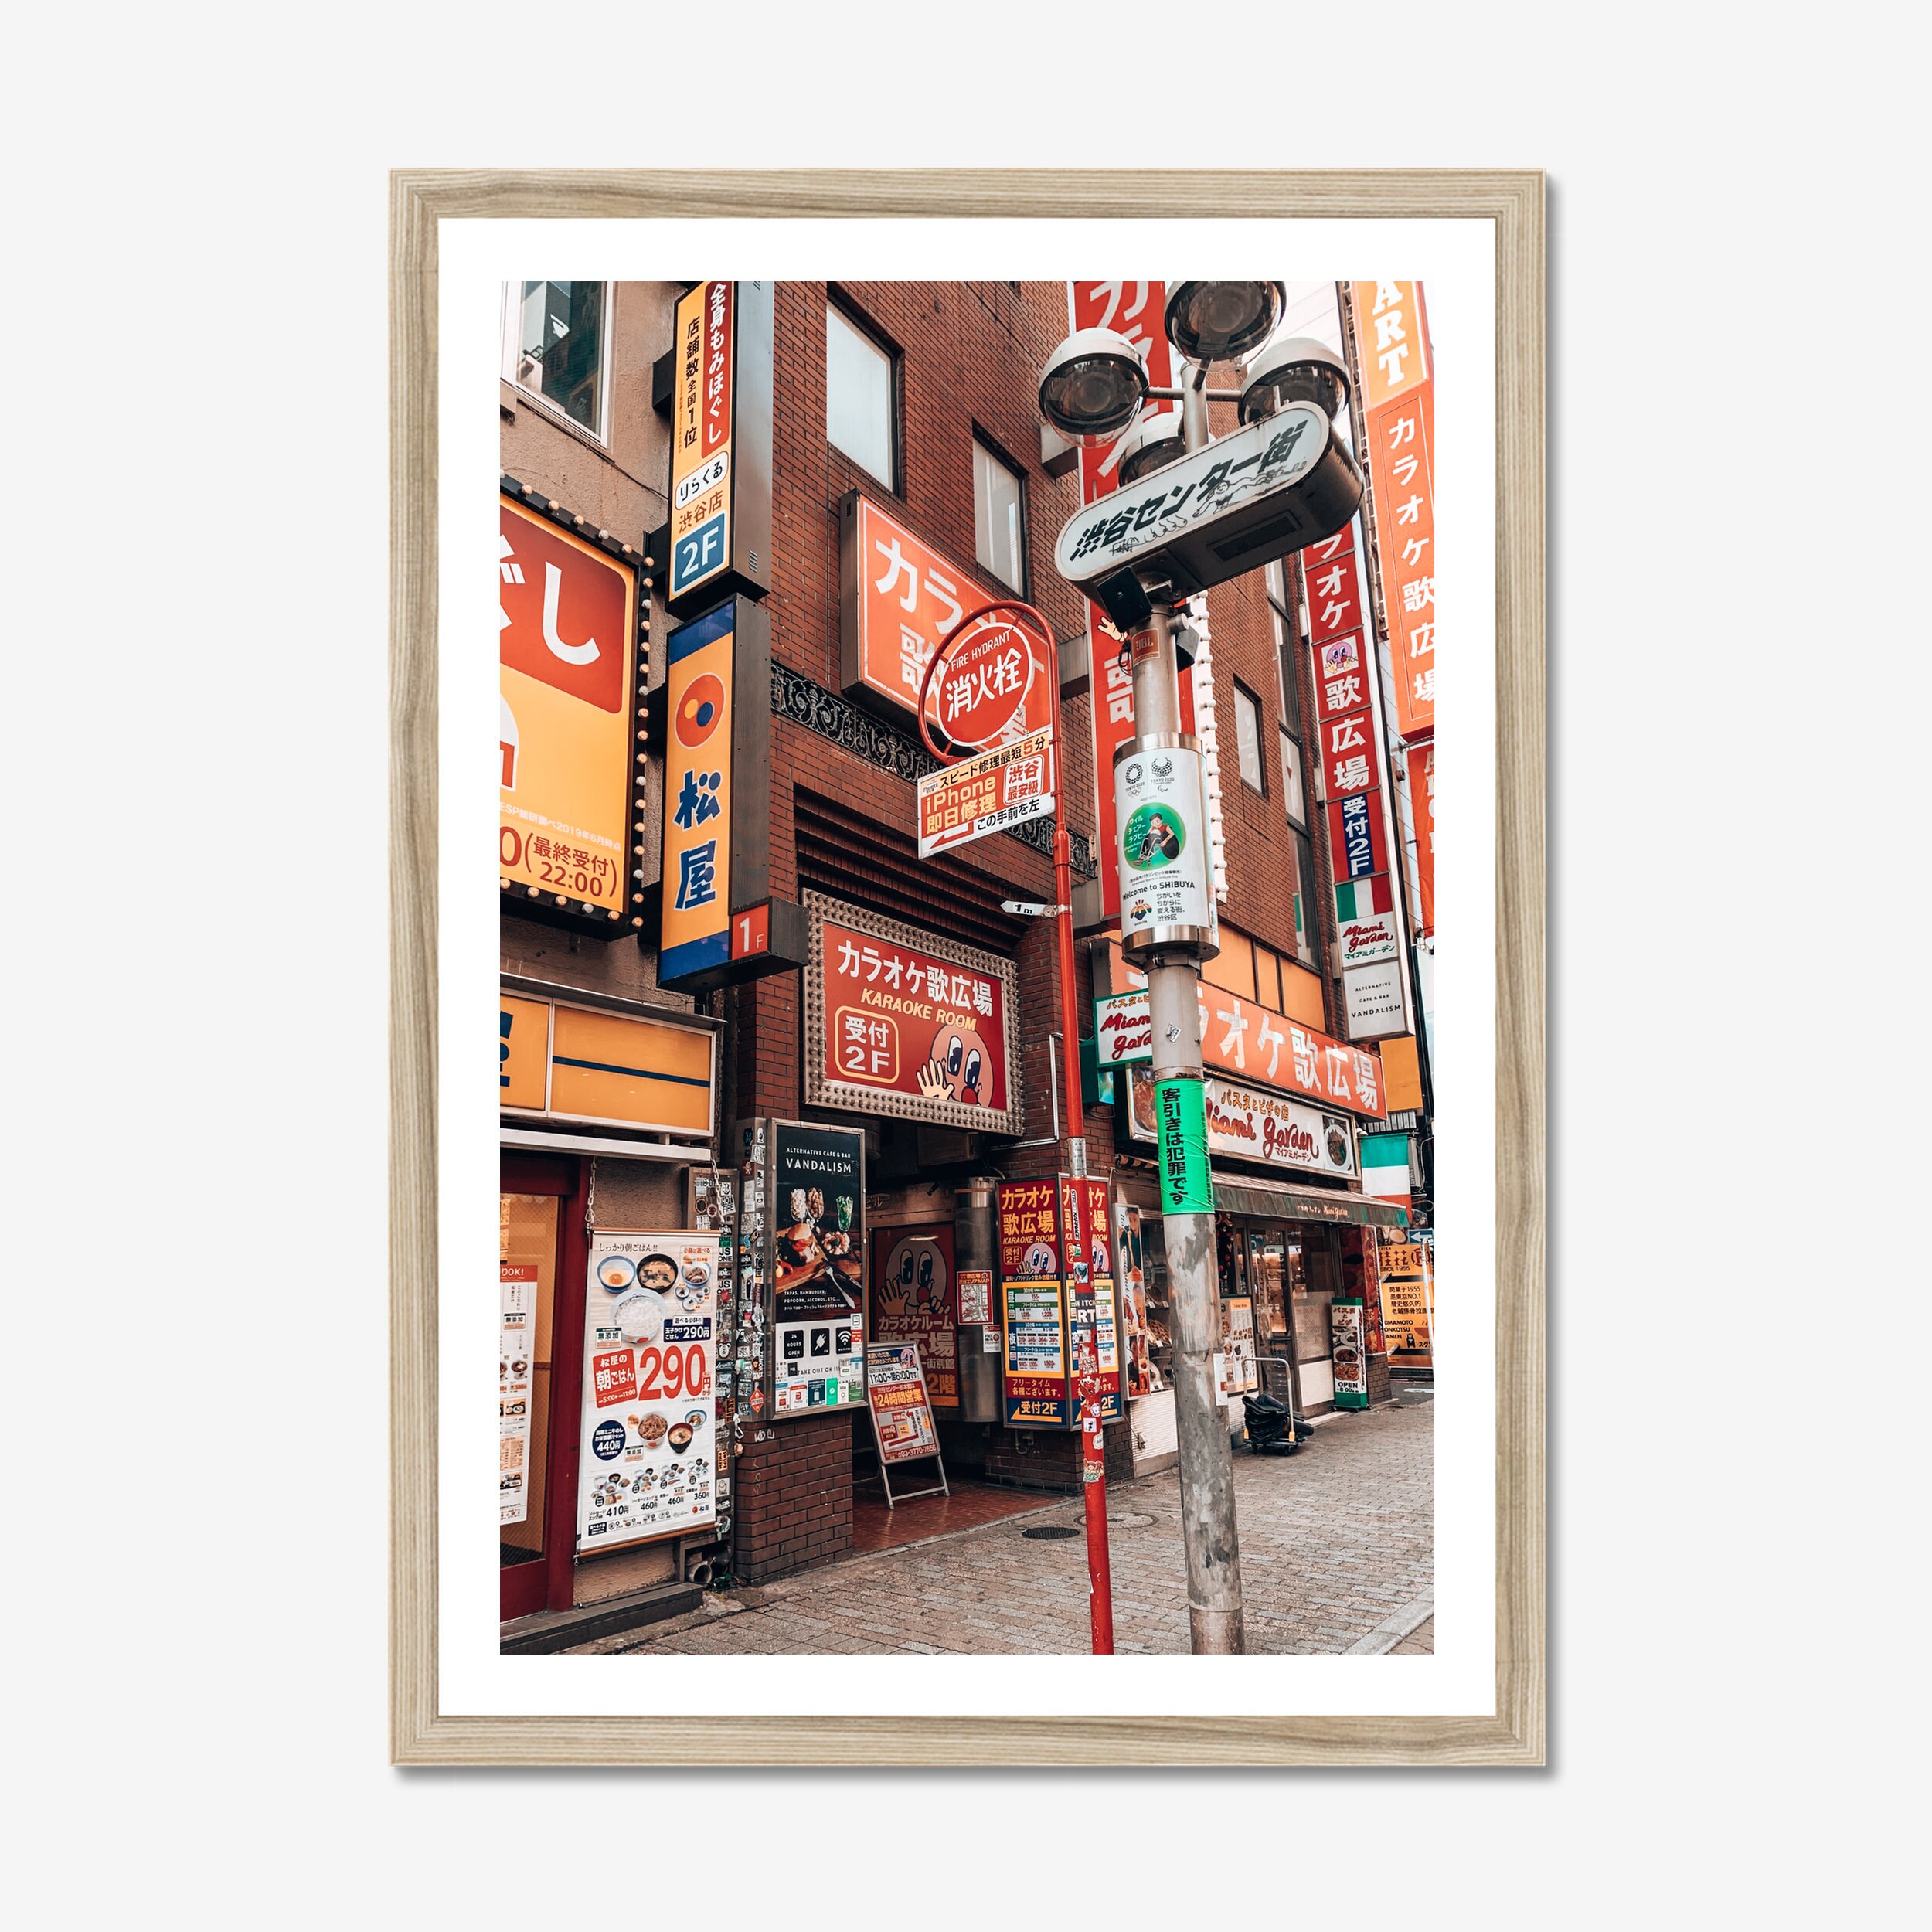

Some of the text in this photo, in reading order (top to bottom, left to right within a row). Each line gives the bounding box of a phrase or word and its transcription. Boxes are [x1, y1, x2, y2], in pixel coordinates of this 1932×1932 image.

[708, 282, 726, 444] 全身もみほぐし
[679, 460, 724, 502] りらくる
[1069, 419, 1309, 562] 渋谷センター街
[679, 489, 723, 534] 渋谷店
[681, 525, 720, 580] 2F
[951, 630, 1012, 672] FIRE HYDRANT
[1135, 636, 1154, 651] JBL
[945, 647, 1022, 723] 消火栓
[1325, 675, 1369, 791] 歌広場
[940, 736, 1046, 789] スピード修理最短5分
[1009, 760, 1039, 784] 渋谷
[927, 775, 996, 814] iPhone
[1007, 780, 1039, 801] 最安級
[927, 791, 997, 835] 即日修理
[977, 798, 1040, 831] この手前を左
[674, 767, 722, 913] 松屋
[1342, 795, 1369, 876] 受付2F
[1123, 886, 1148, 901] Welcome
[1159, 880, 1196, 889] SHIBUYA
[740, 917, 764, 953] 1F
[1342, 921, 1385, 940] Miami
[1343, 945, 1396, 961] マイアミガーデン
[837, 940, 993, 1018] カラオケ歌広場
[1354, 981, 1392, 993] ALTERNATIVE
[860, 988, 977, 1032] KARAOKE ROOM
[1351, 1004, 1401, 1018] VANDALISM
[845, 1015, 889, 1049] 受付
[845, 1046, 890, 1074] 2F
[1221, 1089, 1291, 1121] パスタとピザの店
[786, 1147, 822, 1157] ALTERNATIVE
[1162, 1087, 1189, 1206] 客引きは犯罪です
[1274, 1146, 1311, 1162] マイアミガーデン
[786, 1158, 852, 1173] VANDALISM
[1002, 1185, 1054, 1211] カラオケ
[1002, 1210, 1054, 1236] 歌広場
[1002, 1234, 1056, 1245] KARAOKE ROOM
[1005, 1248, 1020, 1257] 受付
[1006, 1255, 1019, 1264] 2F
[878, 1314, 955, 1332] カラオケルーム
[597, 1332, 619, 1340] 無添加
[600, 1354, 627, 1368] 松屋の
[638, 1344, 706, 1401] 290
[596, 1369, 634, 1391] 朝ごはん
[926, 1373, 956, 1395] 2階
[1012, 1378, 1051, 1387] フリータイム
[879, 1389, 923, 1407] 24時間営業
[1020, 1400, 1058, 1415] 受付2F
[597, 1440, 621, 1452] 440円
[606, 1505, 629, 1517] 410円
